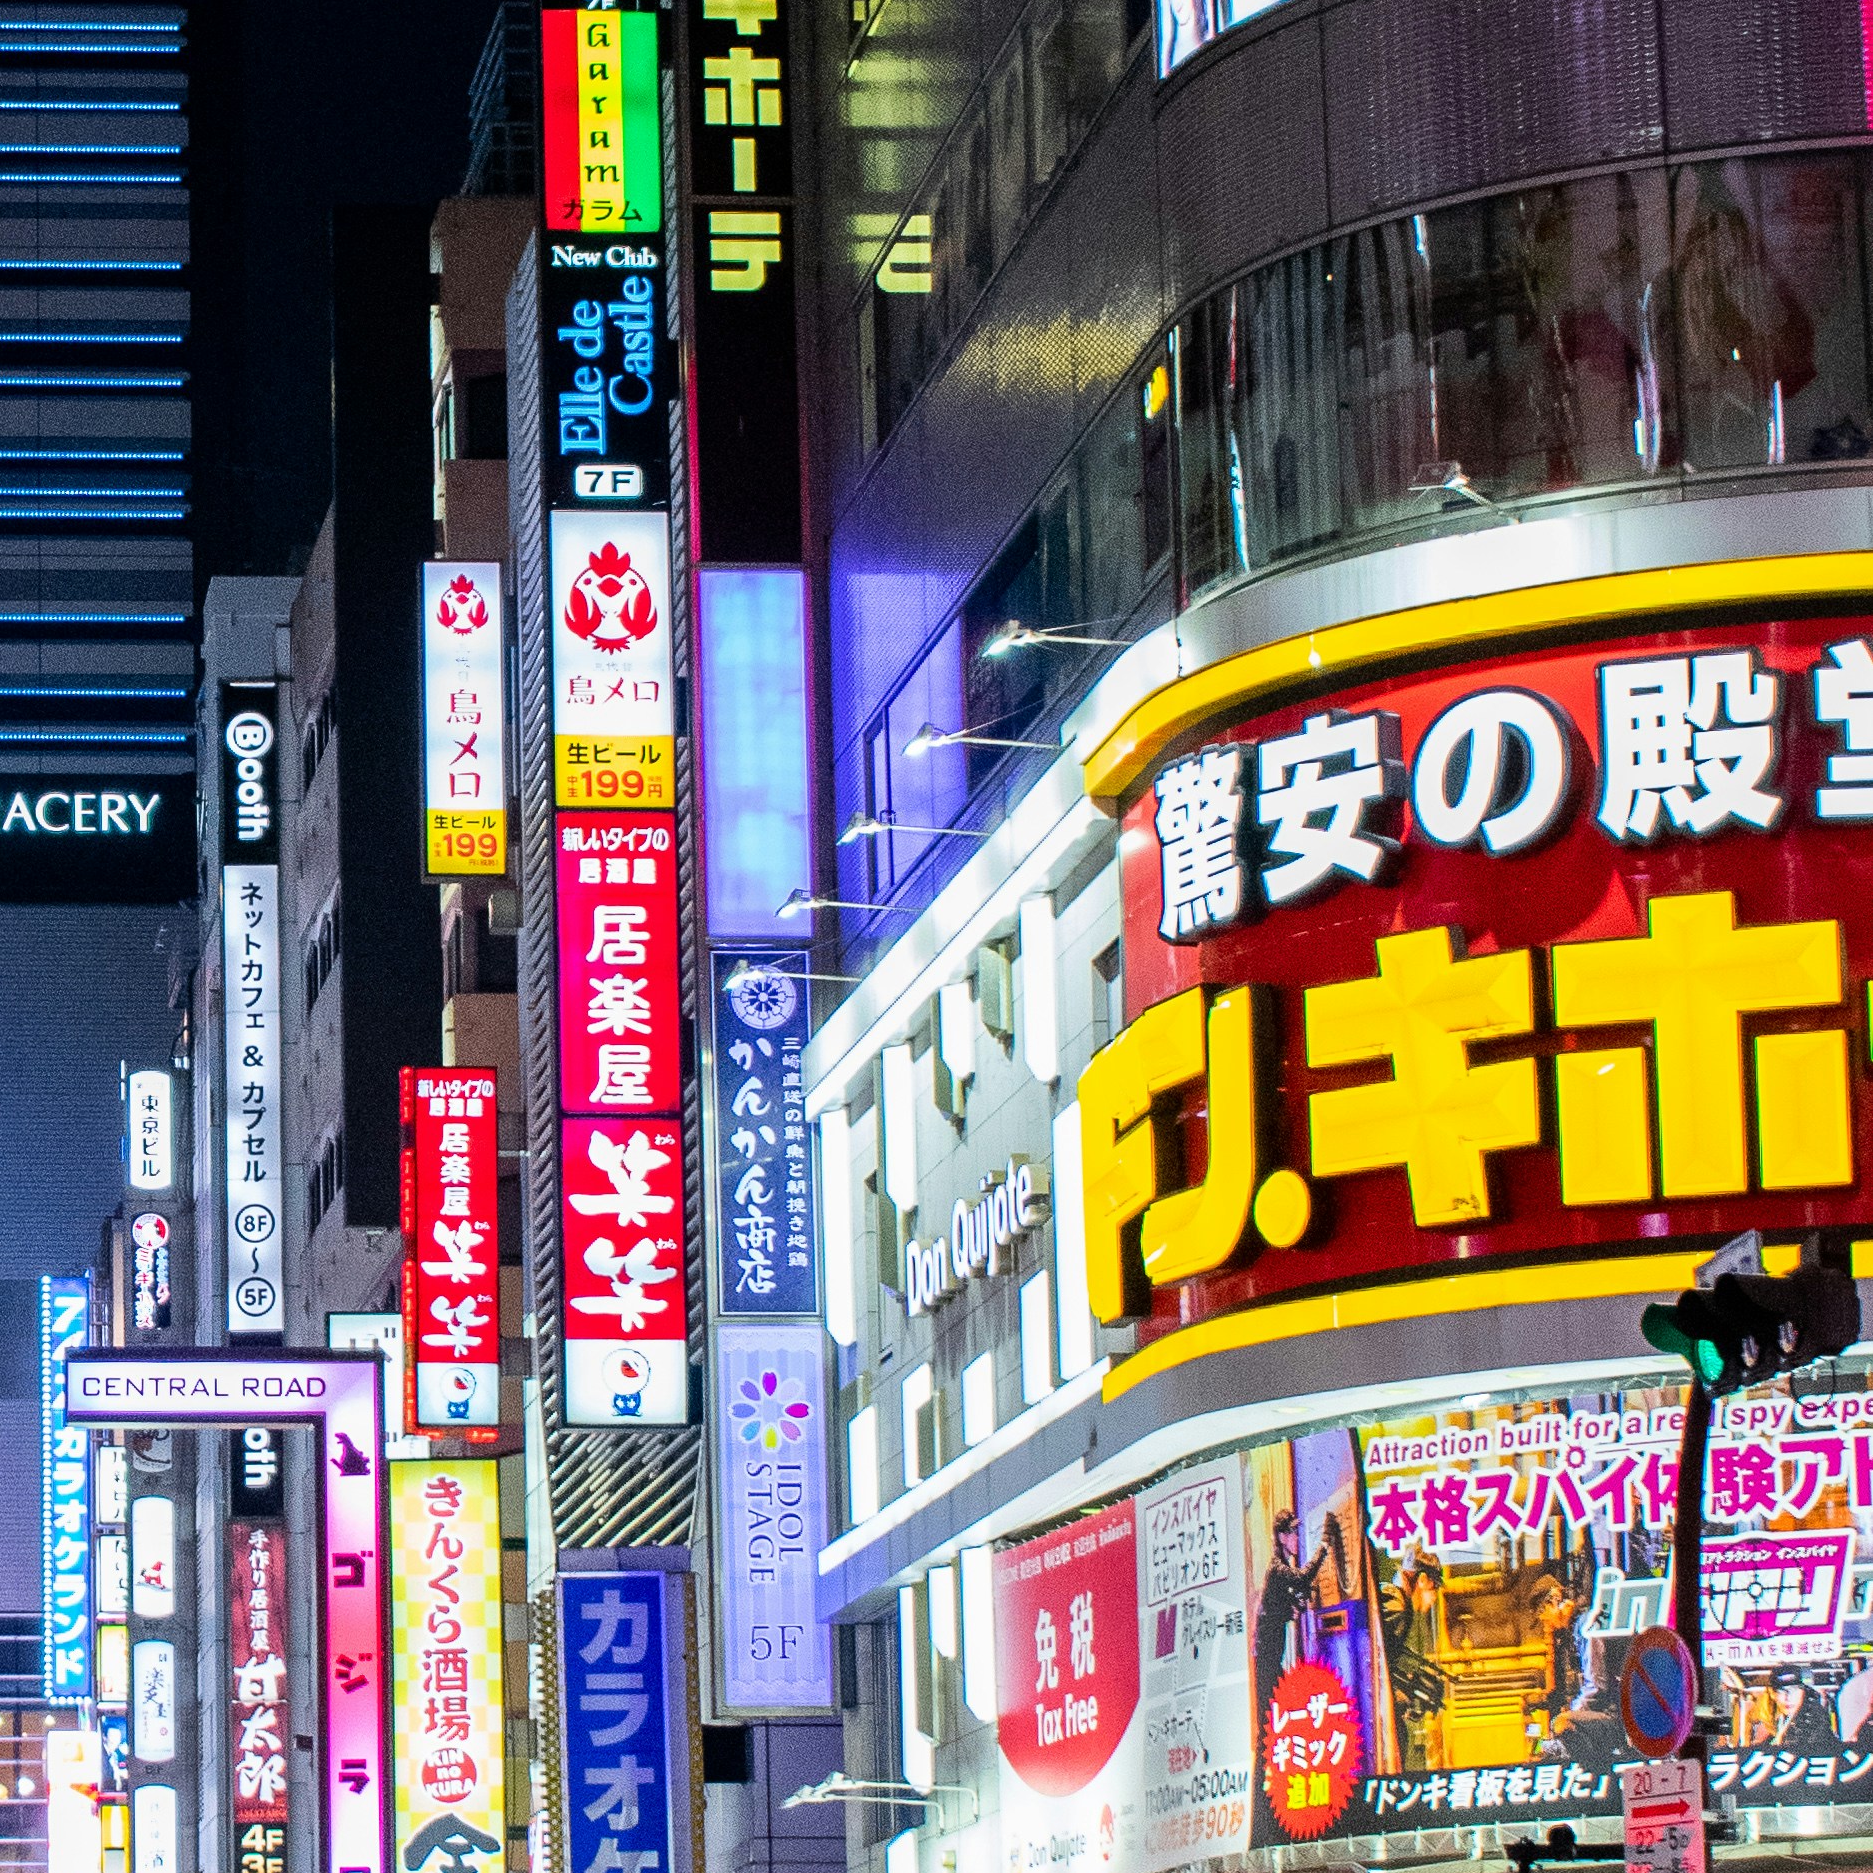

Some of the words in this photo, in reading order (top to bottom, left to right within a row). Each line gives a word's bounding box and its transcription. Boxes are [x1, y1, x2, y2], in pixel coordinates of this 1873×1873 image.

[584, 22, 621, 184] Garam
[563, 198, 643, 222] ガラム
[551, 245, 602, 267] New
[605, 244, 657, 267] Club
[558, 298, 604, 358] de
[609, 274, 655, 417] Castle
[560, 365, 605, 455] Elle
[583, 470, 634, 494] 7F
[564, 675, 659, 705] 鳥メロ
[446, 687, 483, 799] 鳥メロ
[566, 742, 662, 764] 生ビール
[580, 769, 645, 801] 199
[433, 814, 497, 831] 生ビール
[561, 827, 670, 853] 新しいタイプの
[442, 831, 499, 859] 199
[578, 857, 658, 886] 居酒屋
[240, 881, 266, 1031] ネットカフェ
[585, 903, 655, 1106] 居楽屋
[242, 1043, 264, 1068] &
[416, 1076, 494, 1099] 新しいタイプの
[139, 1094, 161, 1178] 東京ビル
[241, 1082, 268, 1184] カプセル
[438, 1123, 472, 1217] 居楽屋
[728, 1034, 777, 1296] かんかん商店
[241, 1212, 268, 1233] 8F
[906, 1234, 946, 1318] Don
[950, 1161, 1036, 1281] Quijote
[242, 1287, 269, 1308] 5F
[82, 1376, 230, 1398] CENTRAL
[241, 1376, 327, 1398] ROAD
[1365, 1430, 1490, 1468] Attraction
[1498, 1418, 1563, 1451] built
[1573, 1413, 1615, 1440] for
[1625, 1414, 1641, 1435] a
[1729, 1399, 1787, 1432] spy
[744, 1462, 776, 1585] STAGE
[775, 1462, 804, 1564] IDOL
[246, 1528, 270, 1651] 手作り居酒屋
[420, 1474, 473, 1742] きんくら酒場
[749, 1622, 805, 1662] 5F
[1033, 1590, 1097, 1694] 免税
[232, 1651, 288, 1804] 甘太郎
[1035, 1702, 1063, 1748] Tax
[1064, 1692, 1099, 1735] Free
[1272, 1699, 1348, 1732] レーザー
[429, 1748, 465, 1767] KIN
[1272, 1730, 1348, 1769] ギミック
[425, 1777, 475, 1800] KURA
[436, 1764, 461, 1780] no
[1285, 1771, 1330, 1810] 追加
[240, 1825, 285, 1854] 4F
